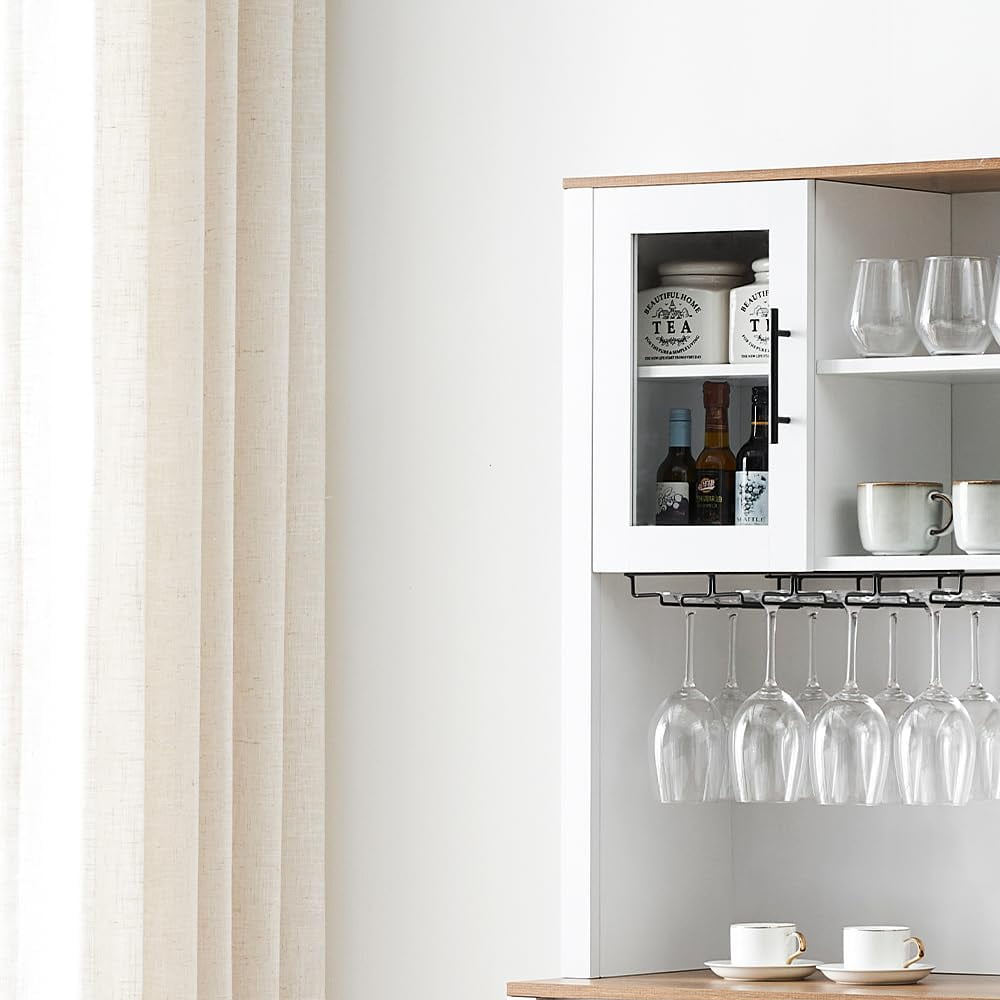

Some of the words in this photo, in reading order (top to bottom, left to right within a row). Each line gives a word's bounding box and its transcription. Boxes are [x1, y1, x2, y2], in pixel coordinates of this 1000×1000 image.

[644, 291, 680, 315] BEAUTIFUL
[680, 294, 702, 314] HOME
[652, 320, 692, 334] TEA
